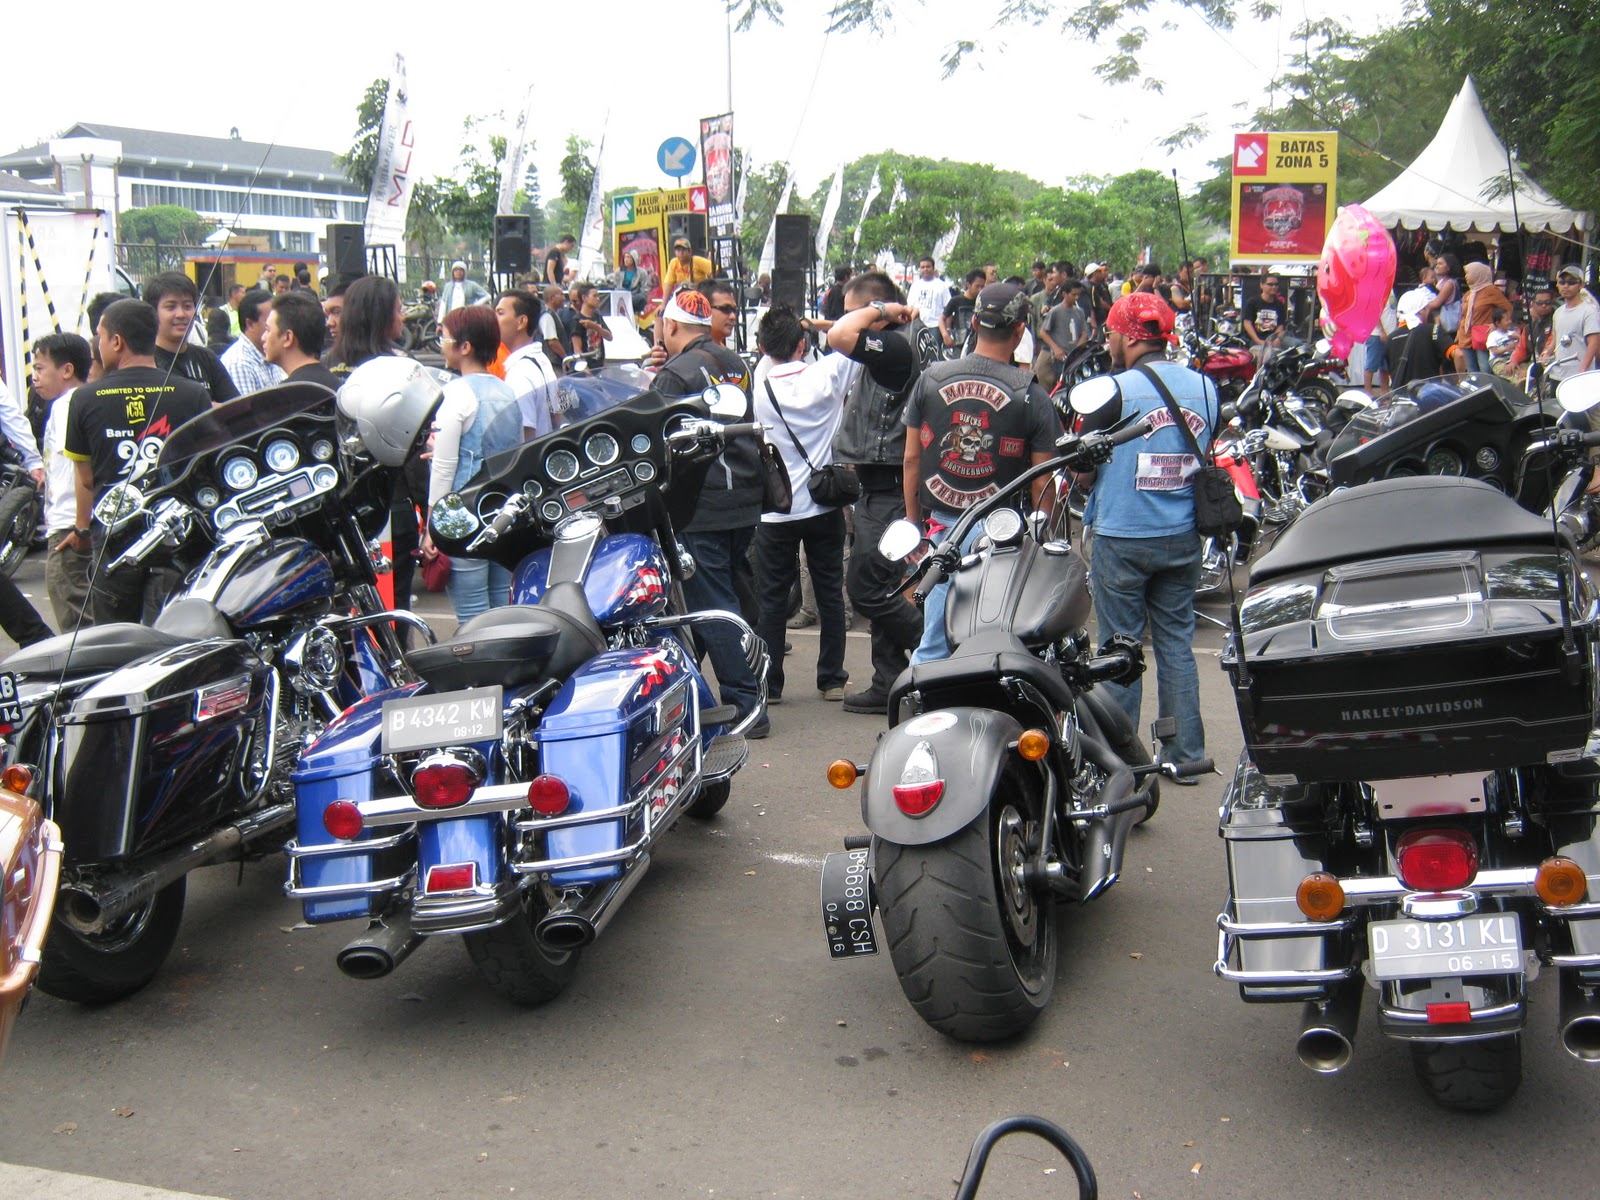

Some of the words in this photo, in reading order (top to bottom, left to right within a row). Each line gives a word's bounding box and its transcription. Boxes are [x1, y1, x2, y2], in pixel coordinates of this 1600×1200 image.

[1281, 140, 1325, 153] BATAS
[1275, 156, 1313, 168] ZONA
[1319, 154, 1329, 168] 5
[638, 195, 659, 206] JALUR
[667, 193, 687, 203] JALUR
[96, 387, 133, 396] COMMITED
[145, 386, 175, 394] QUALITY
[943, 382, 1007, 408] MOTHER
[105, 428, 135, 438] Baru
[943, 460, 993, 476] BROTHERHOOD
[0, 676, 14, 698] B
[393, 711, 405, 731] B
[410, 704, 460, 728] 4342
[470, 698, 496, 720] KW
[849, 851, 868, 860] B
[845, 865, 865, 911] 6688
[826, 903, 839, 922] 04
[848, 918, 873, 953] CSH
[1372, 927, 1389, 953] D
[1404, 921, 1466, 950] 3131
[1479, 917, 1517, 945] KL
[832, 936, 845, 952] 16
